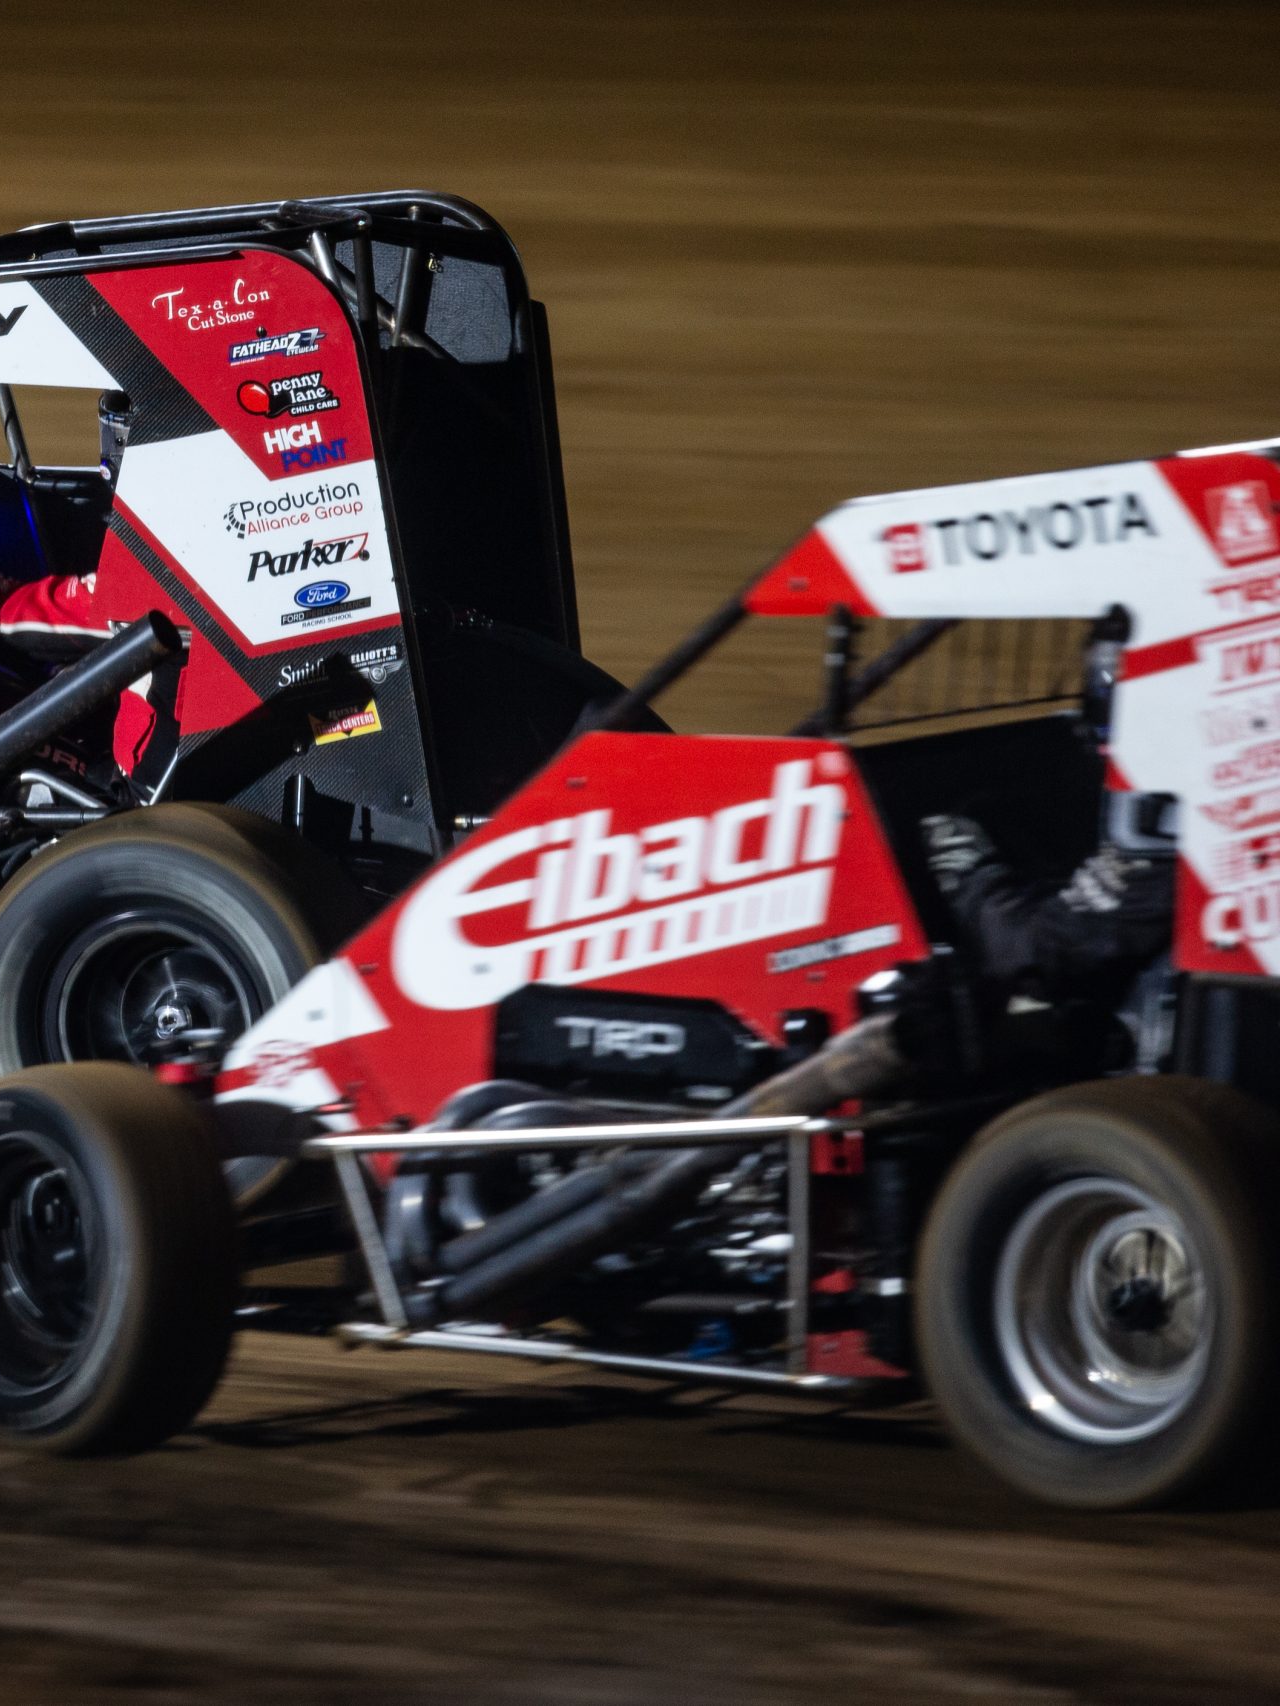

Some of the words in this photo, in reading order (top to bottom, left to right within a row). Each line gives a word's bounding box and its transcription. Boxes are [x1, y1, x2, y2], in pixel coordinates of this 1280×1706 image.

[188, 316, 215, 331] Cut
[216, 310, 255, 325] Stone
[286, 344, 319, 356] EYEWEAR
[271, 373, 321, 396] penny
[290, 387, 326, 404] lane
[291, 404, 315, 415] CHILD
[317, 399, 338, 410] CARE
[263, 420, 322, 454] HIGH
[281, 438, 348, 472] POINT
[240, 482, 360, 520] Production
[247, 512, 310, 536] Alliance
[315, 501, 363, 520] Group
[930, 492, 1160, 566] TOYOTA
[247, 538, 354, 582] Parker
[307, 585, 337, 603] Ford
[281, 612, 305, 625] FORD
[328, 612, 353, 622] SCHOOL
[342, 712, 375, 730] CENTERS
[392, 757, 845, 1010] Eibach
[554, 1016, 686, 1059] TRD
